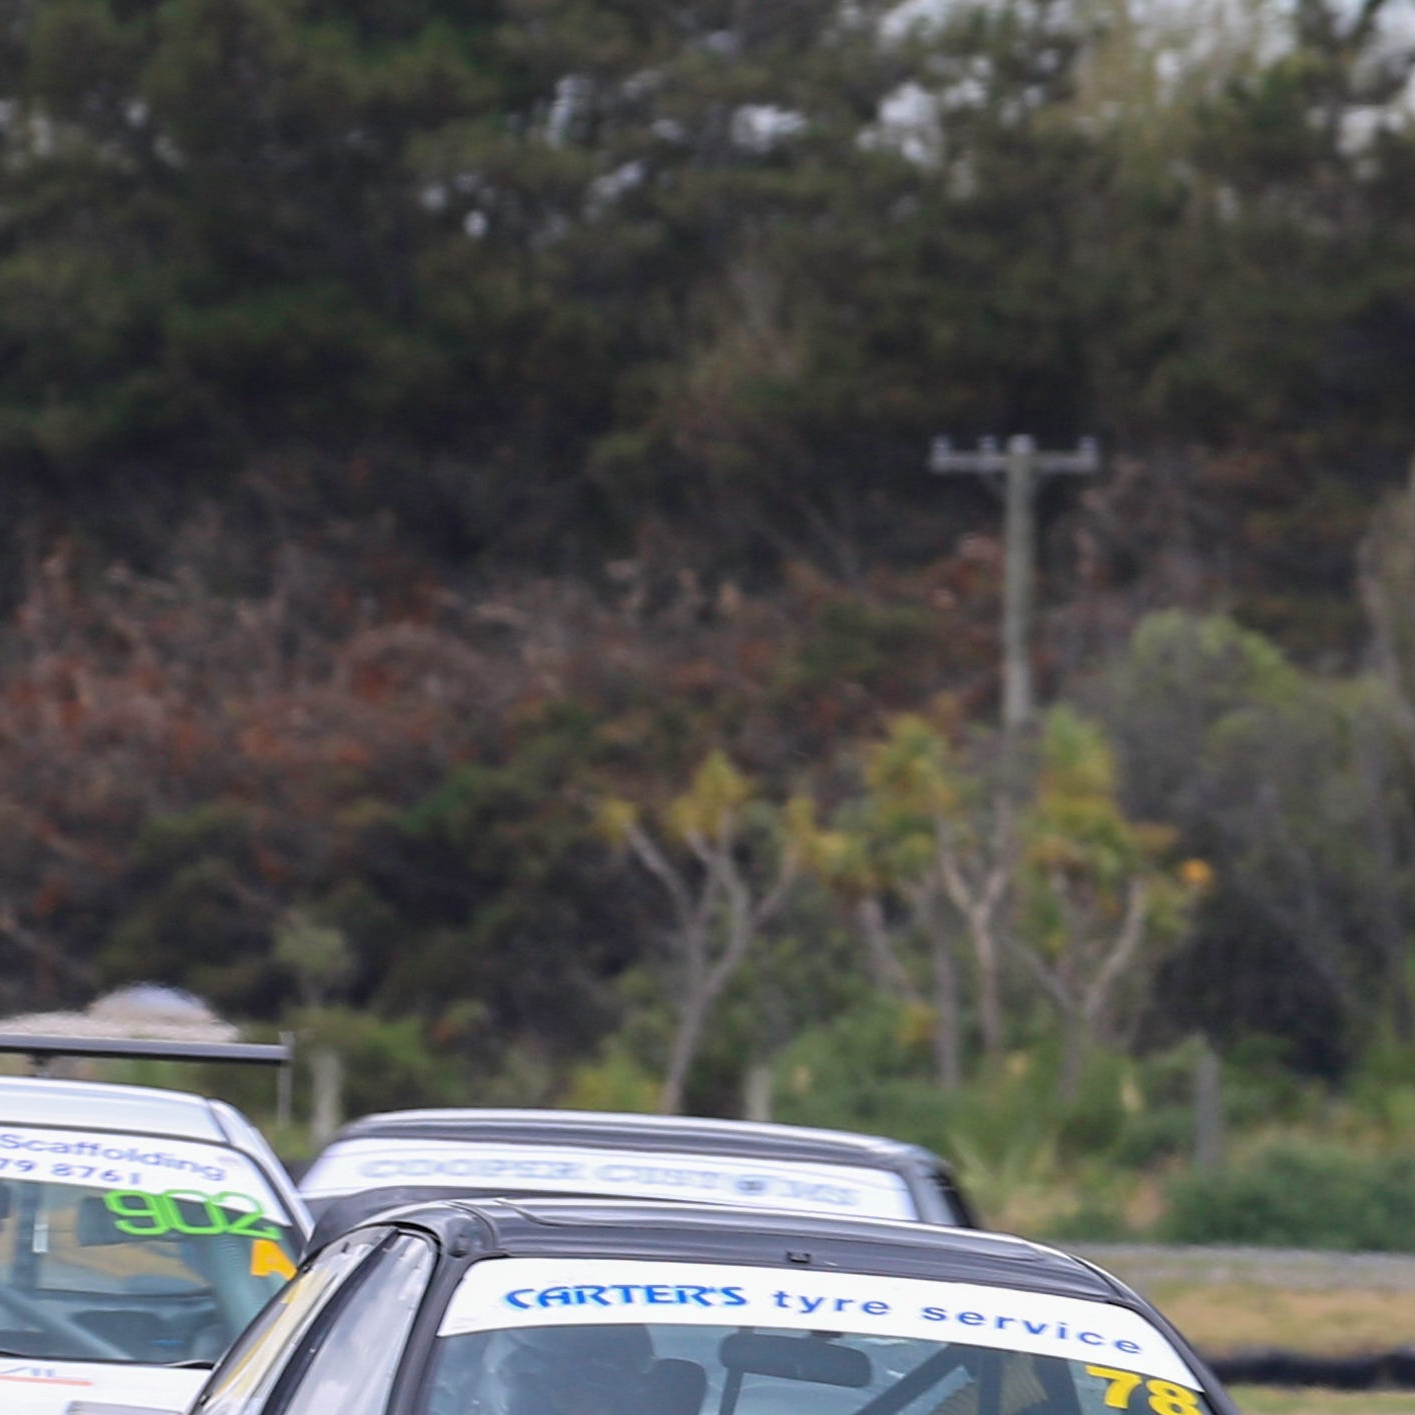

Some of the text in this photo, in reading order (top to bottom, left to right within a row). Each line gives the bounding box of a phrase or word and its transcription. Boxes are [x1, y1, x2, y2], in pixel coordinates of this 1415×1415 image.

[50, 1162, 143, 1185] 8761
[102, 1188, 284, 1241] 902
[503, 1282, 1143, 1356] CARTER'S tyre service
